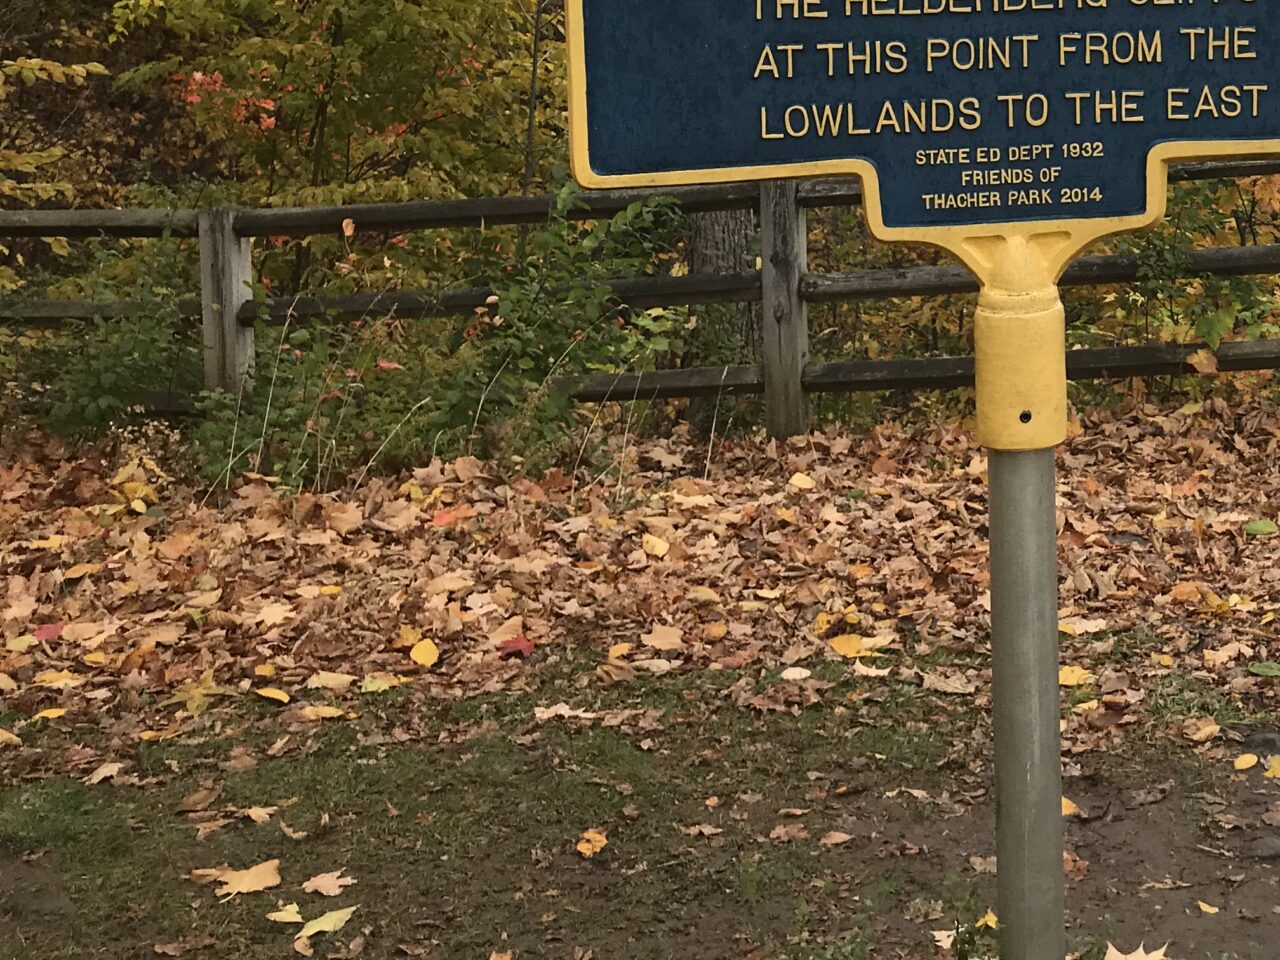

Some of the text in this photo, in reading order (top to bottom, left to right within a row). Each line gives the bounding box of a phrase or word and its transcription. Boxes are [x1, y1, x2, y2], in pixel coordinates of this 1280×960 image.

[753, 26, 1257, 78] AT THIS POINT FROM THE
[761, 85, 1268, 139] LOWLANDS TO THE EAST
[915, 141, 1104, 165] STATE ED DEPT 1932
[961, 166, 1062, 186] FRIENDS OF
[921, 186, 1103, 210] THACHER PARK 2014
